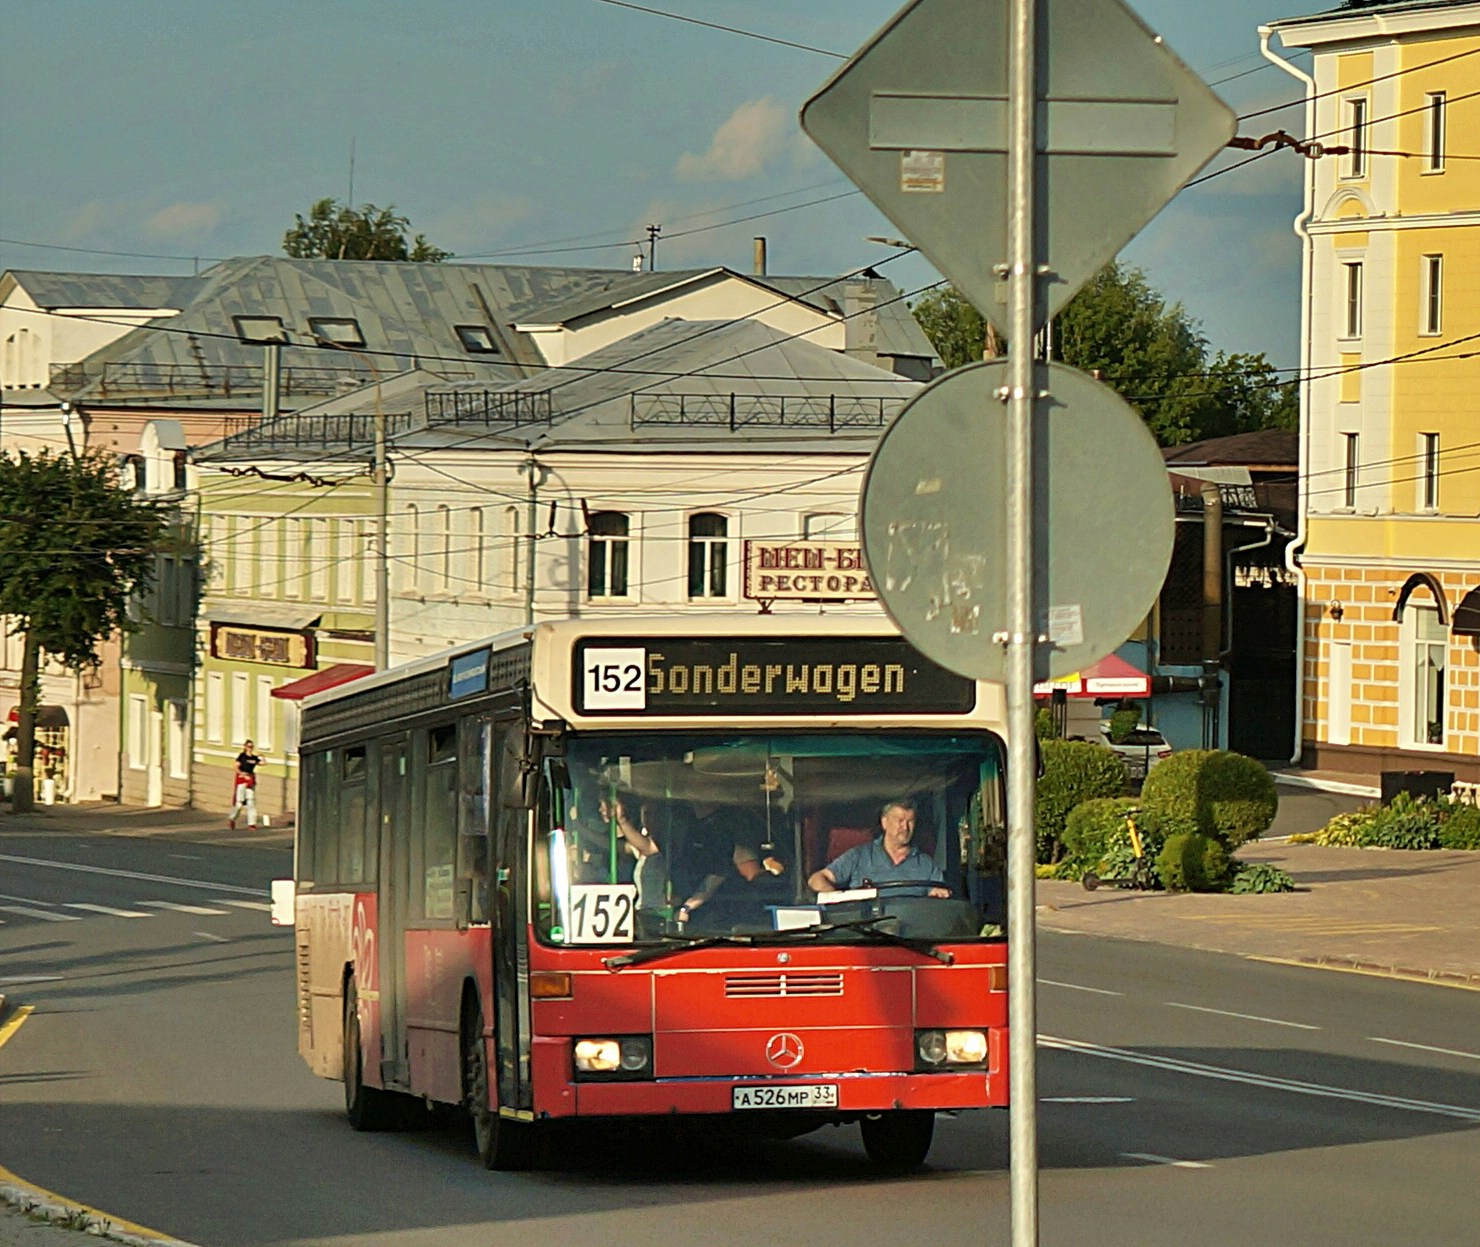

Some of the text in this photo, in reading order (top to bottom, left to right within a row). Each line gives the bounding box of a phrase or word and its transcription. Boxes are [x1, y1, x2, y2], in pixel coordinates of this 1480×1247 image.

[758, 575, 875, 592] РЕСТОРА
[588, 664, 642, 693] 152
[648, 652, 904, 702] Sonderwagen
[572, 893, 631, 938] 152
